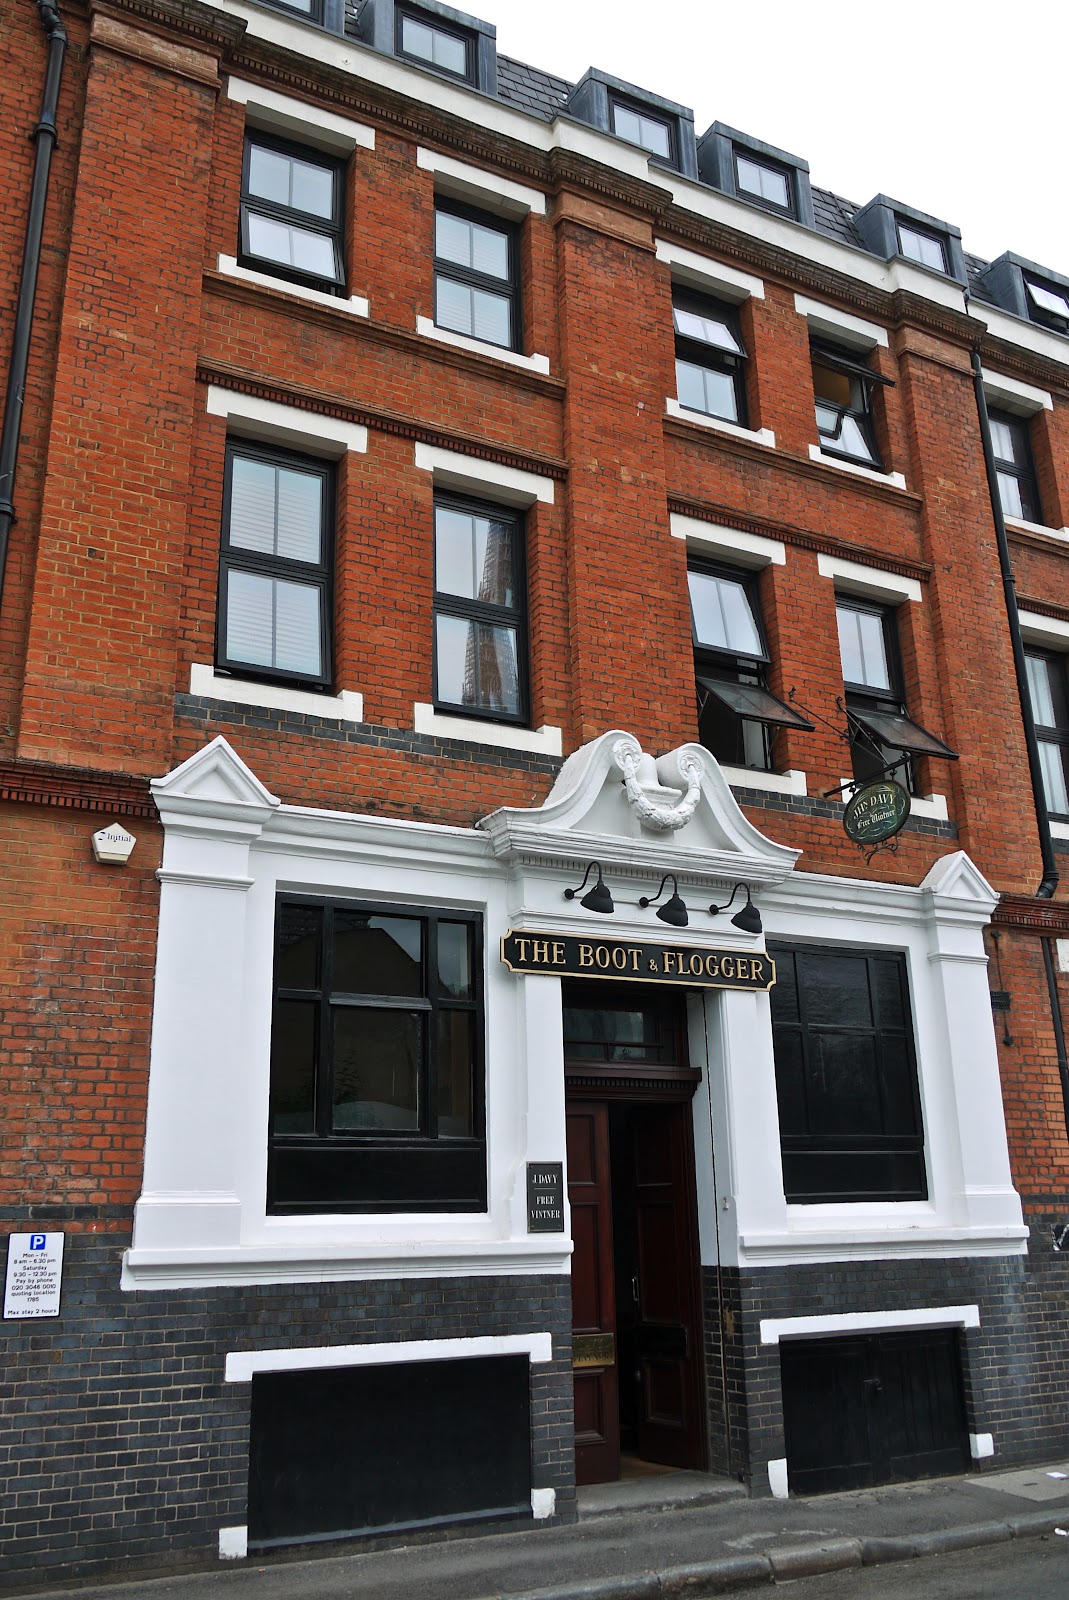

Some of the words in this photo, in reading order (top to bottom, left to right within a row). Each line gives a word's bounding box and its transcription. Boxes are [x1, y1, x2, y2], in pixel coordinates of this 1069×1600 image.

[870, 794, 896, 806] DAVY
[857, 819, 870, 829] Free
[107, 833, 132, 842] Initial
[514, 938, 566, 965] THE
[578, 944, 643, 971] BOOT
[648, 958, 659, 972] &
[662, 951, 765, 981] FLOGGER
[538, 1174, 558, 1184] DAVY
[536, 1196, 554, 1205] FREE
[531, 1210, 560, 1219] VINTNER
[33, 1236, 44, 1249] P
